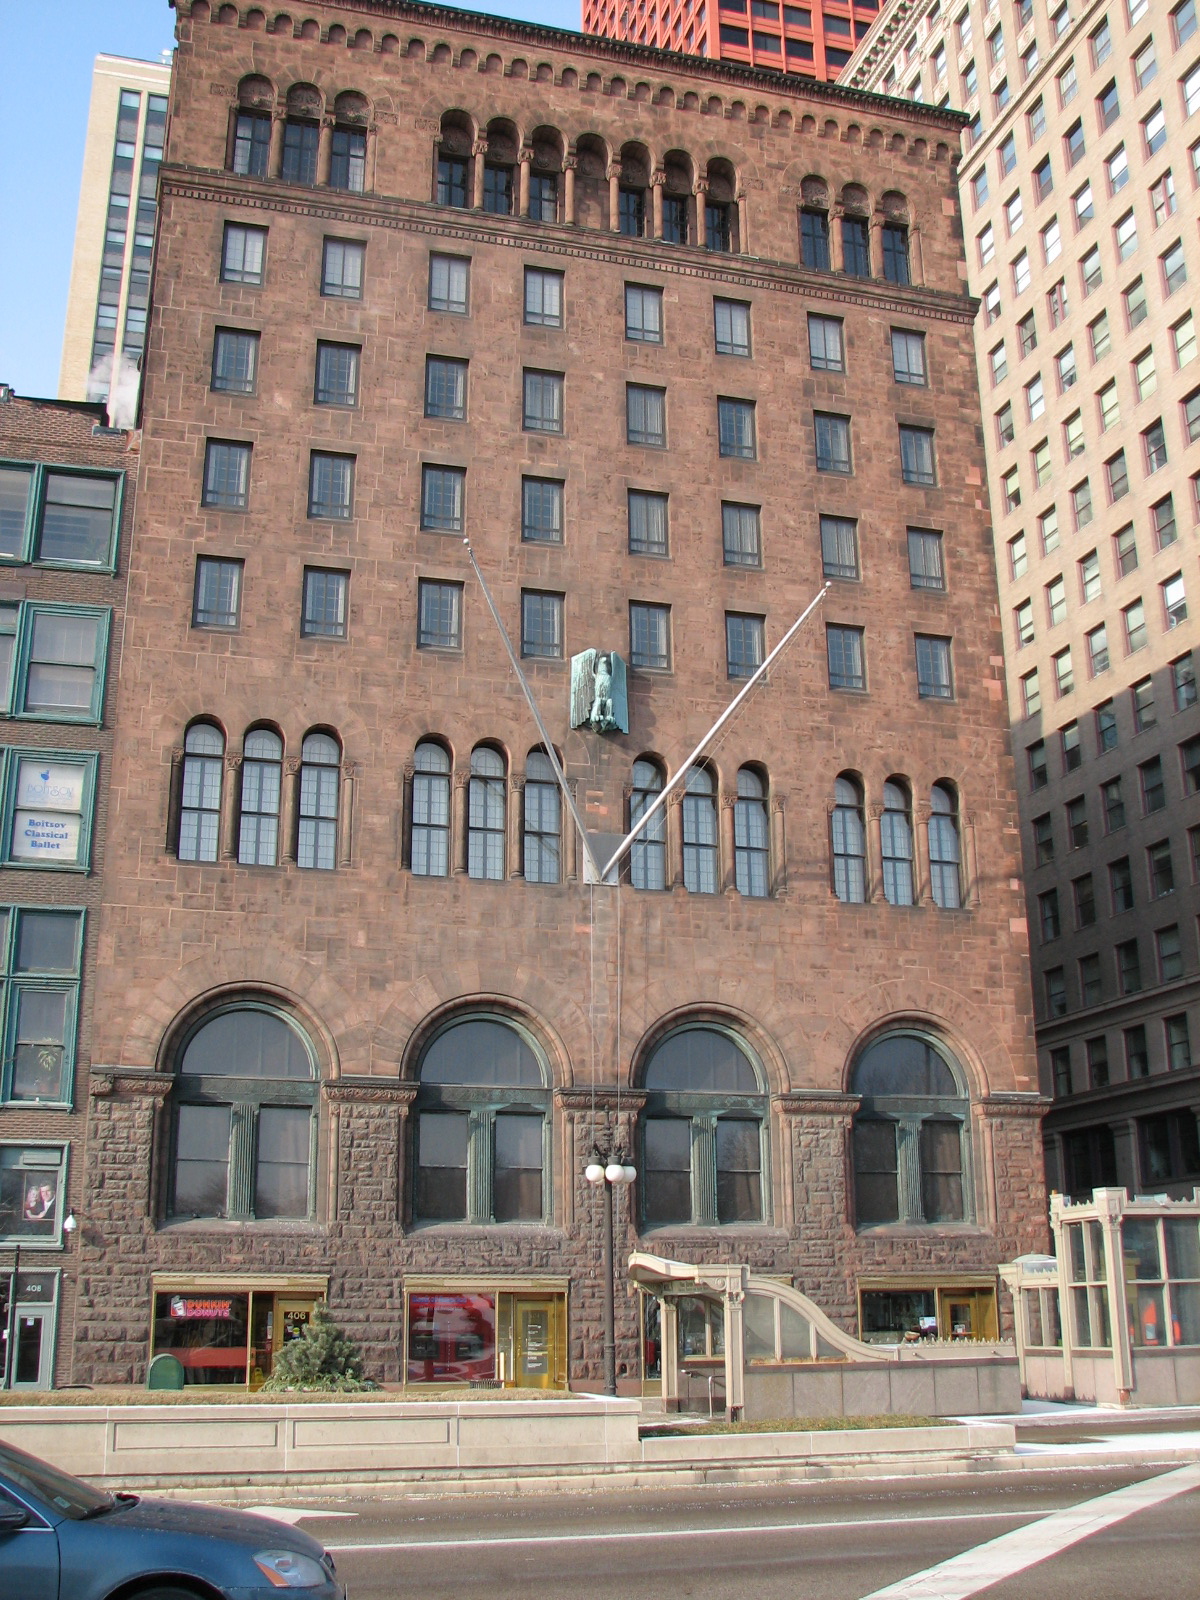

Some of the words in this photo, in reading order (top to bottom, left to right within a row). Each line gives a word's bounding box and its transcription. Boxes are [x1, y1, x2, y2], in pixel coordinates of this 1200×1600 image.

[28, 819, 67, 828] Boitsov
[25, 830, 68, 839] Classical
[31, 840, 61, 849] Ballet
[187, 1308, 230, 1317] DONUTS
[287, 1311, 306, 1320] 406
